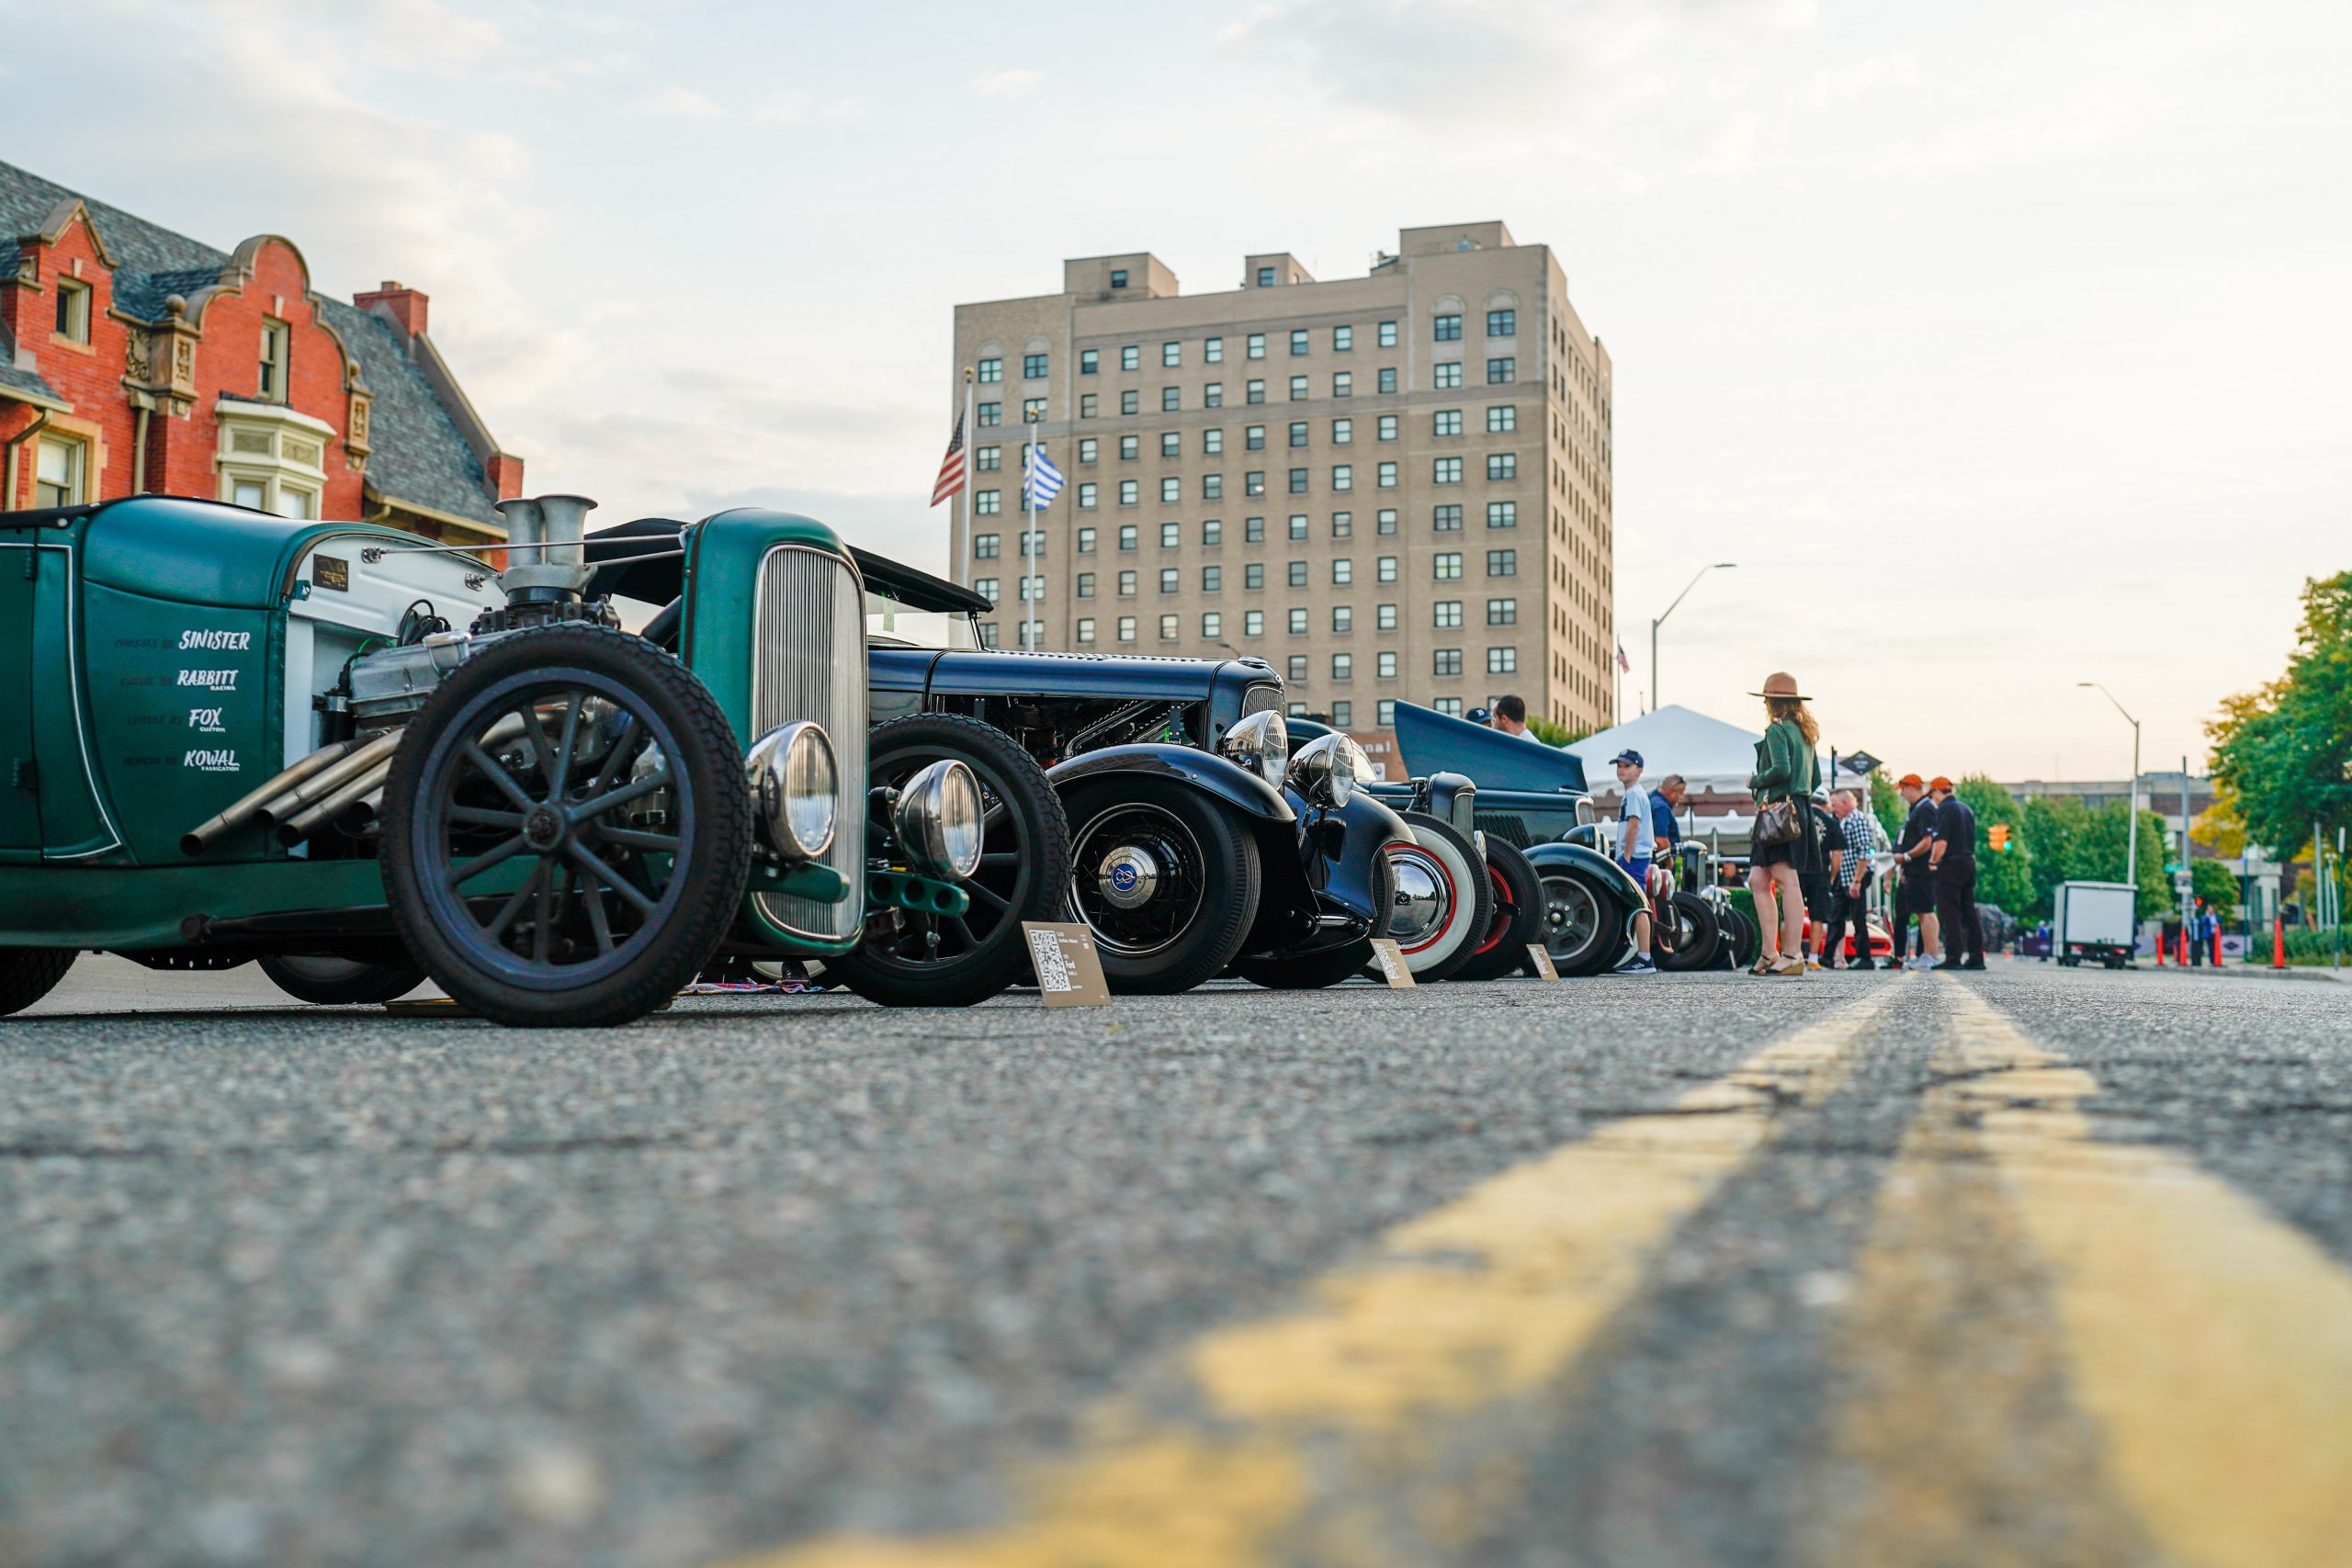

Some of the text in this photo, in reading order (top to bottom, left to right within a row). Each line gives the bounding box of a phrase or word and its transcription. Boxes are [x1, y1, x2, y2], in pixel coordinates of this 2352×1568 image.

[178, 629, 250, 650] SINISTER
[177, 670, 239, 686] RABBITT
[189, 707, 222, 728] FOX
[184, 750, 240, 767] KOWAL
